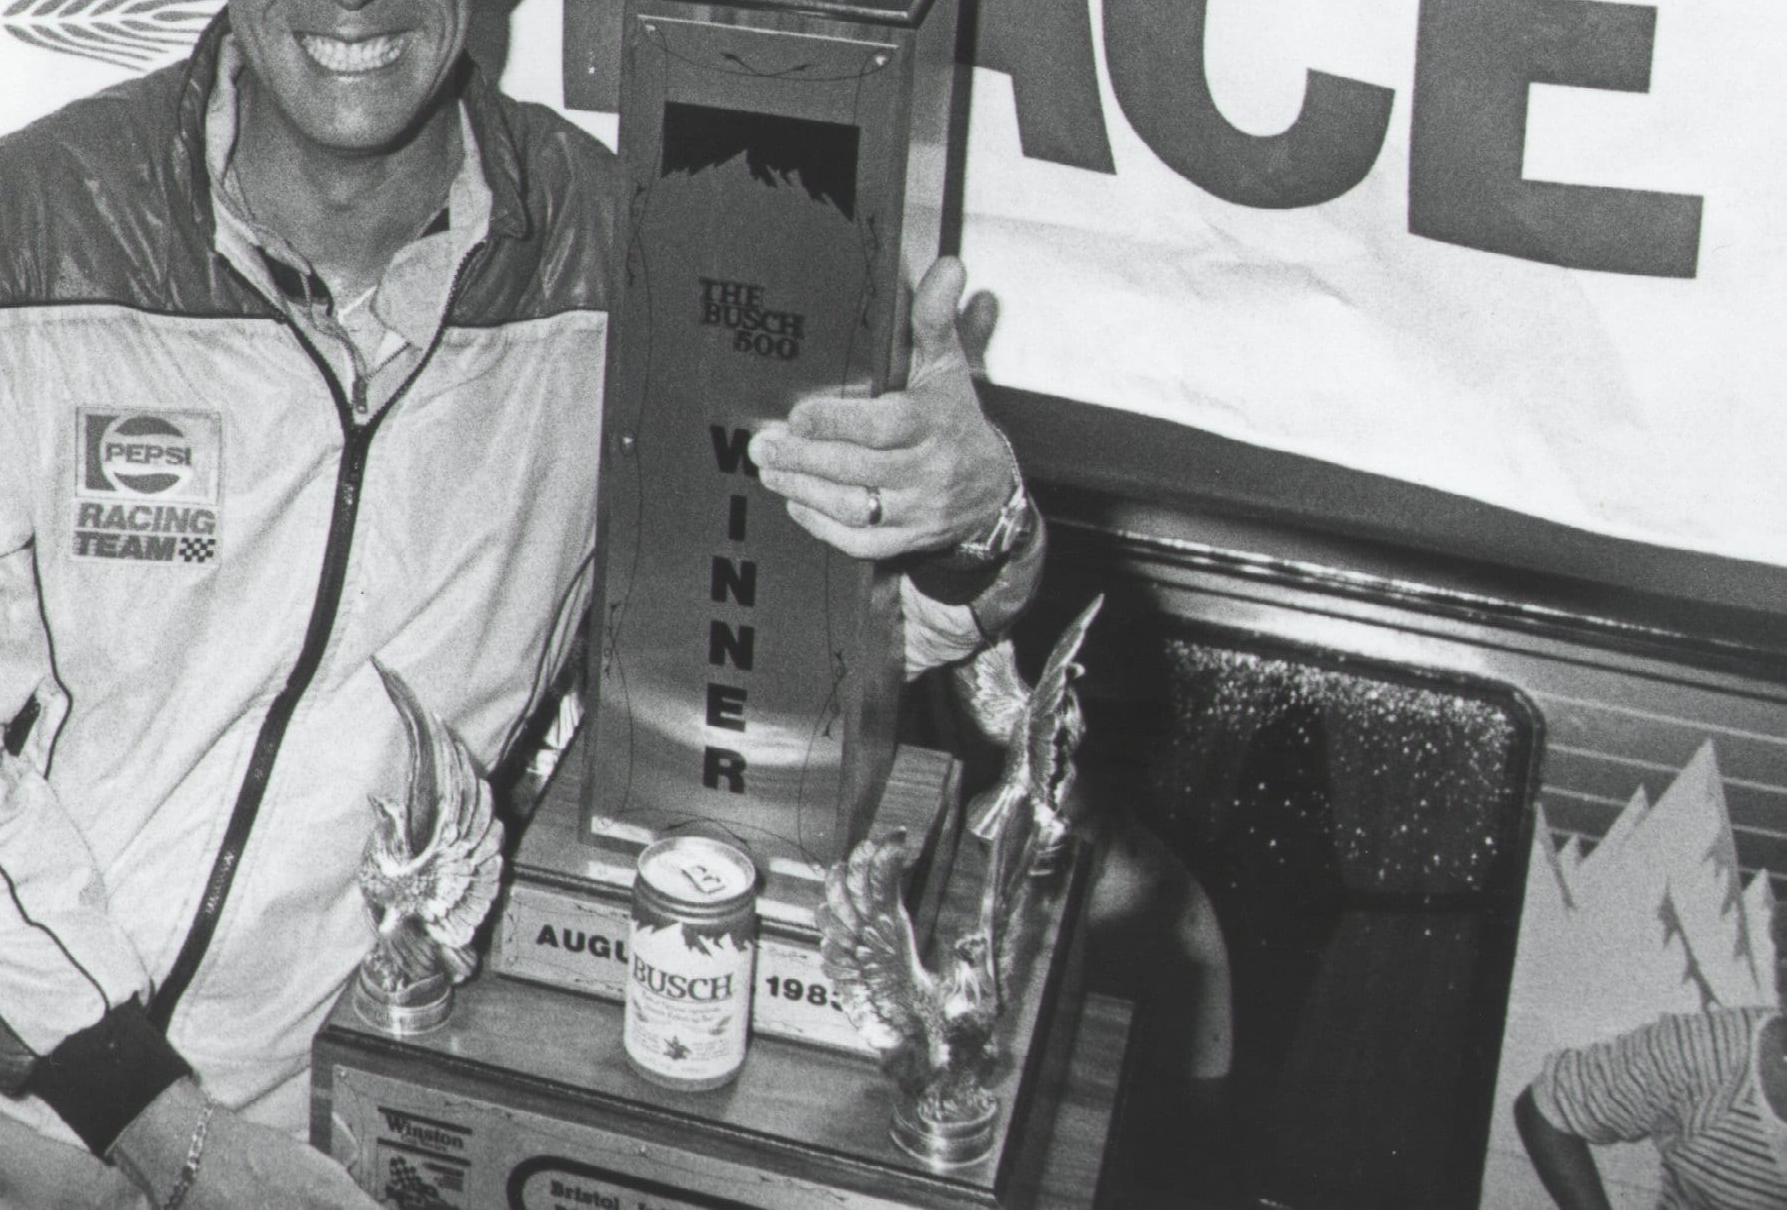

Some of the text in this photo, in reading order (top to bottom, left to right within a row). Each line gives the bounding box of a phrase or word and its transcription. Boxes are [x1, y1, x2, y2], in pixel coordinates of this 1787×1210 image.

[699, 276, 764, 308] THE
[700, 301, 806, 340] BUSCH
[733, 330, 800, 361] 500
[105, 442, 192, 466] PEPSI
[77, 503, 216, 535] RACING
[74, 531, 177, 561] TEAM
[703, 425, 759, 795] WINNER
[632, 953, 733, 1002] BUSCH
[384, 1111, 464, 1149] Winston
[550, 1180, 620, 1210] Bristol
